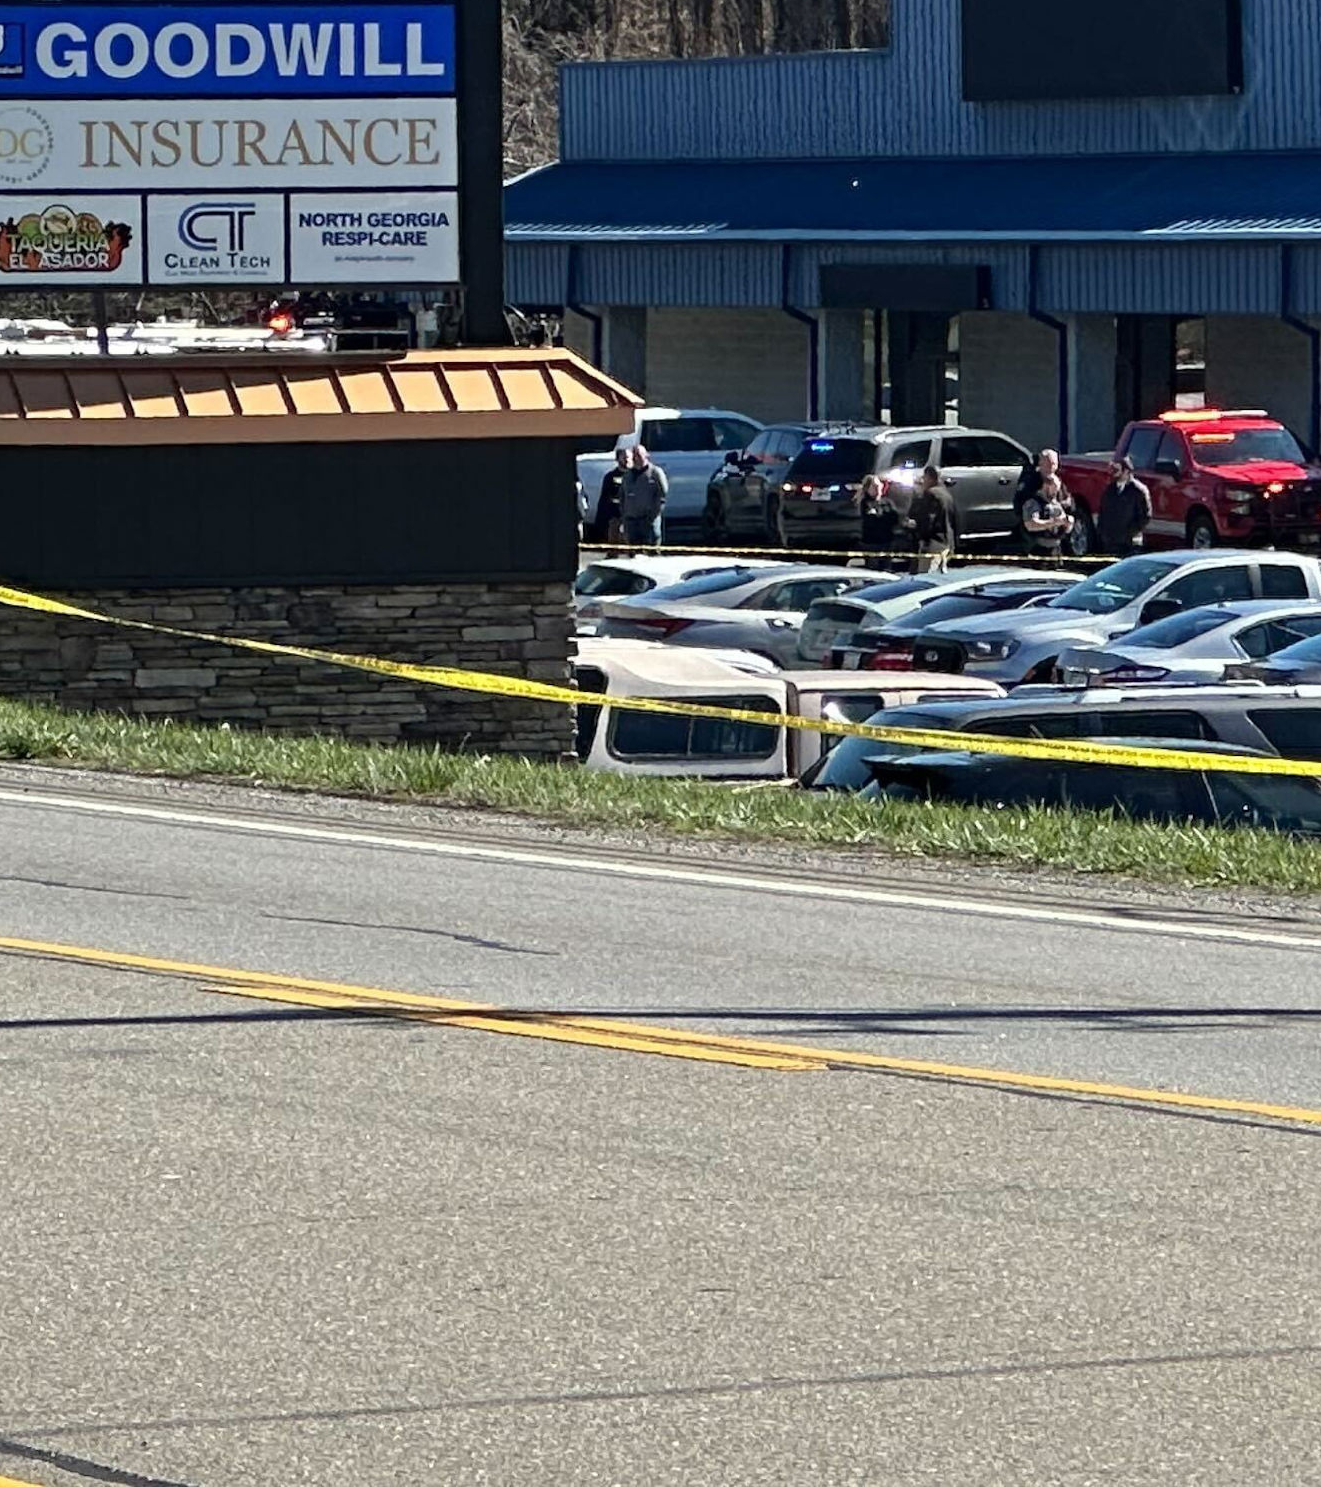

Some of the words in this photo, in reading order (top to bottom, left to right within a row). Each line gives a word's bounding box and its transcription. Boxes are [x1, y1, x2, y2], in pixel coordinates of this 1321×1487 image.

[36, 22, 445, 78] GOODWILL
[78, 118, 441, 168] INSURANCE
[178, 202, 256, 251] CT
[299, 213, 362, 228] NORTH
[367, 212, 450, 228] GEORGIA
[7, 233, 110, 253] TAQUERIA
[322, 231, 428, 246] RESPI-CARE
[9, 254, 30, 269] EL
[38, 252, 109, 268] ASADOR
[165, 253, 220, 268] CLEAN
[227, 252, 270, 268] TECH
